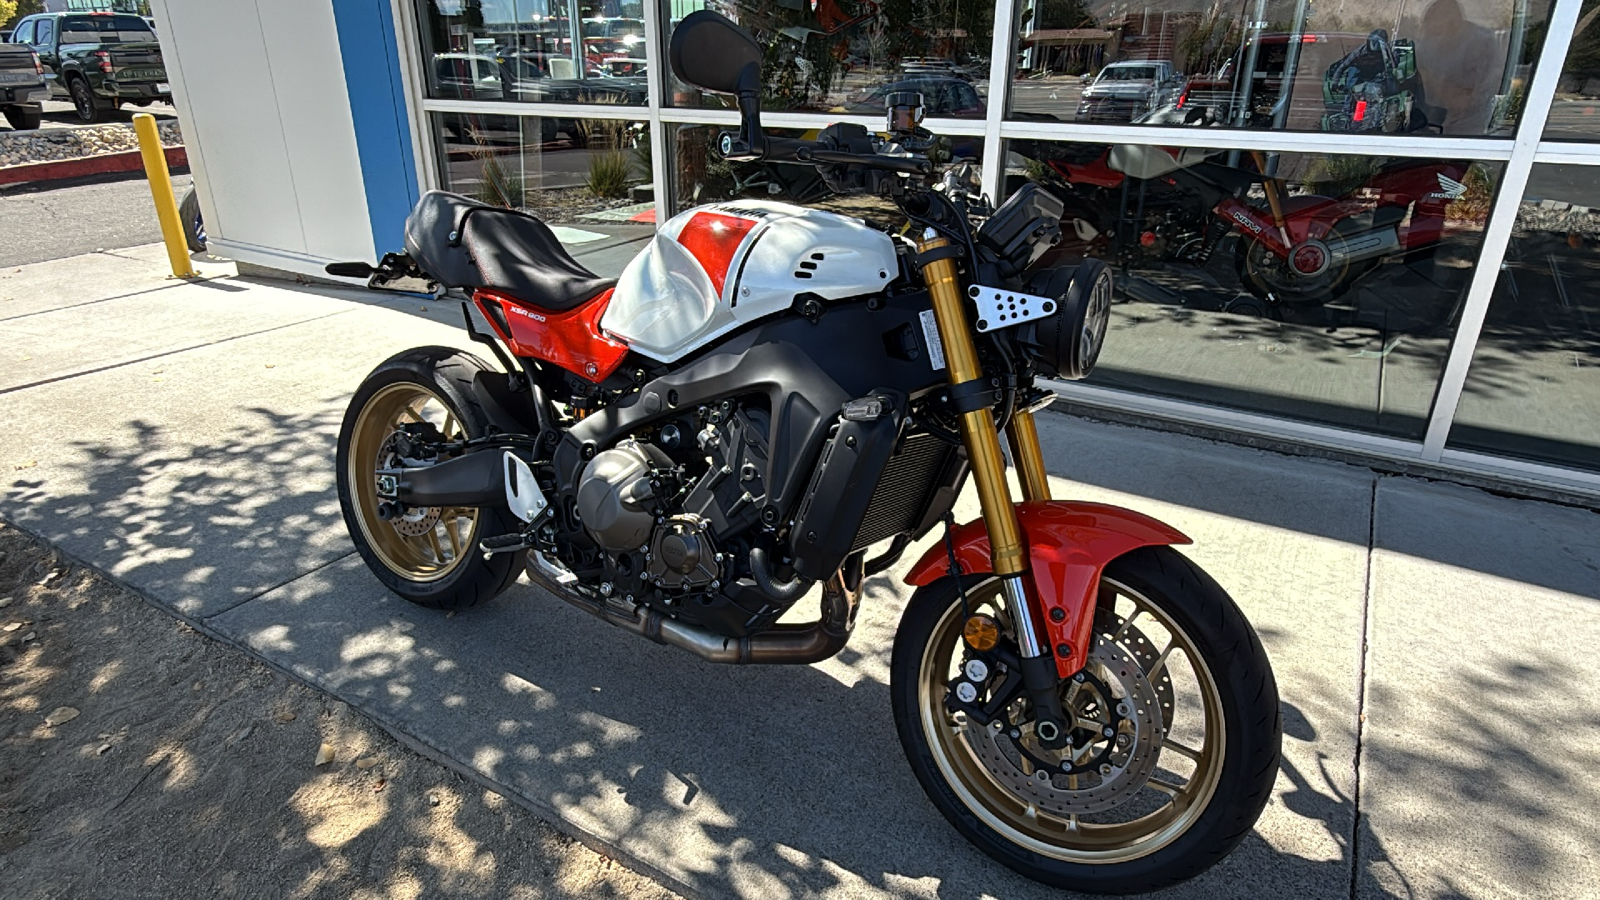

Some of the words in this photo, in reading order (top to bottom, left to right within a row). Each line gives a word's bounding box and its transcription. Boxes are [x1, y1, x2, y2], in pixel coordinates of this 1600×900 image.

[1430, 192, 1466, 201] HONDA
[1233, 211, 1262, 234] NAVI
[510, 306, 528, 316] XSR
[528, 312, 546, 322] 900
